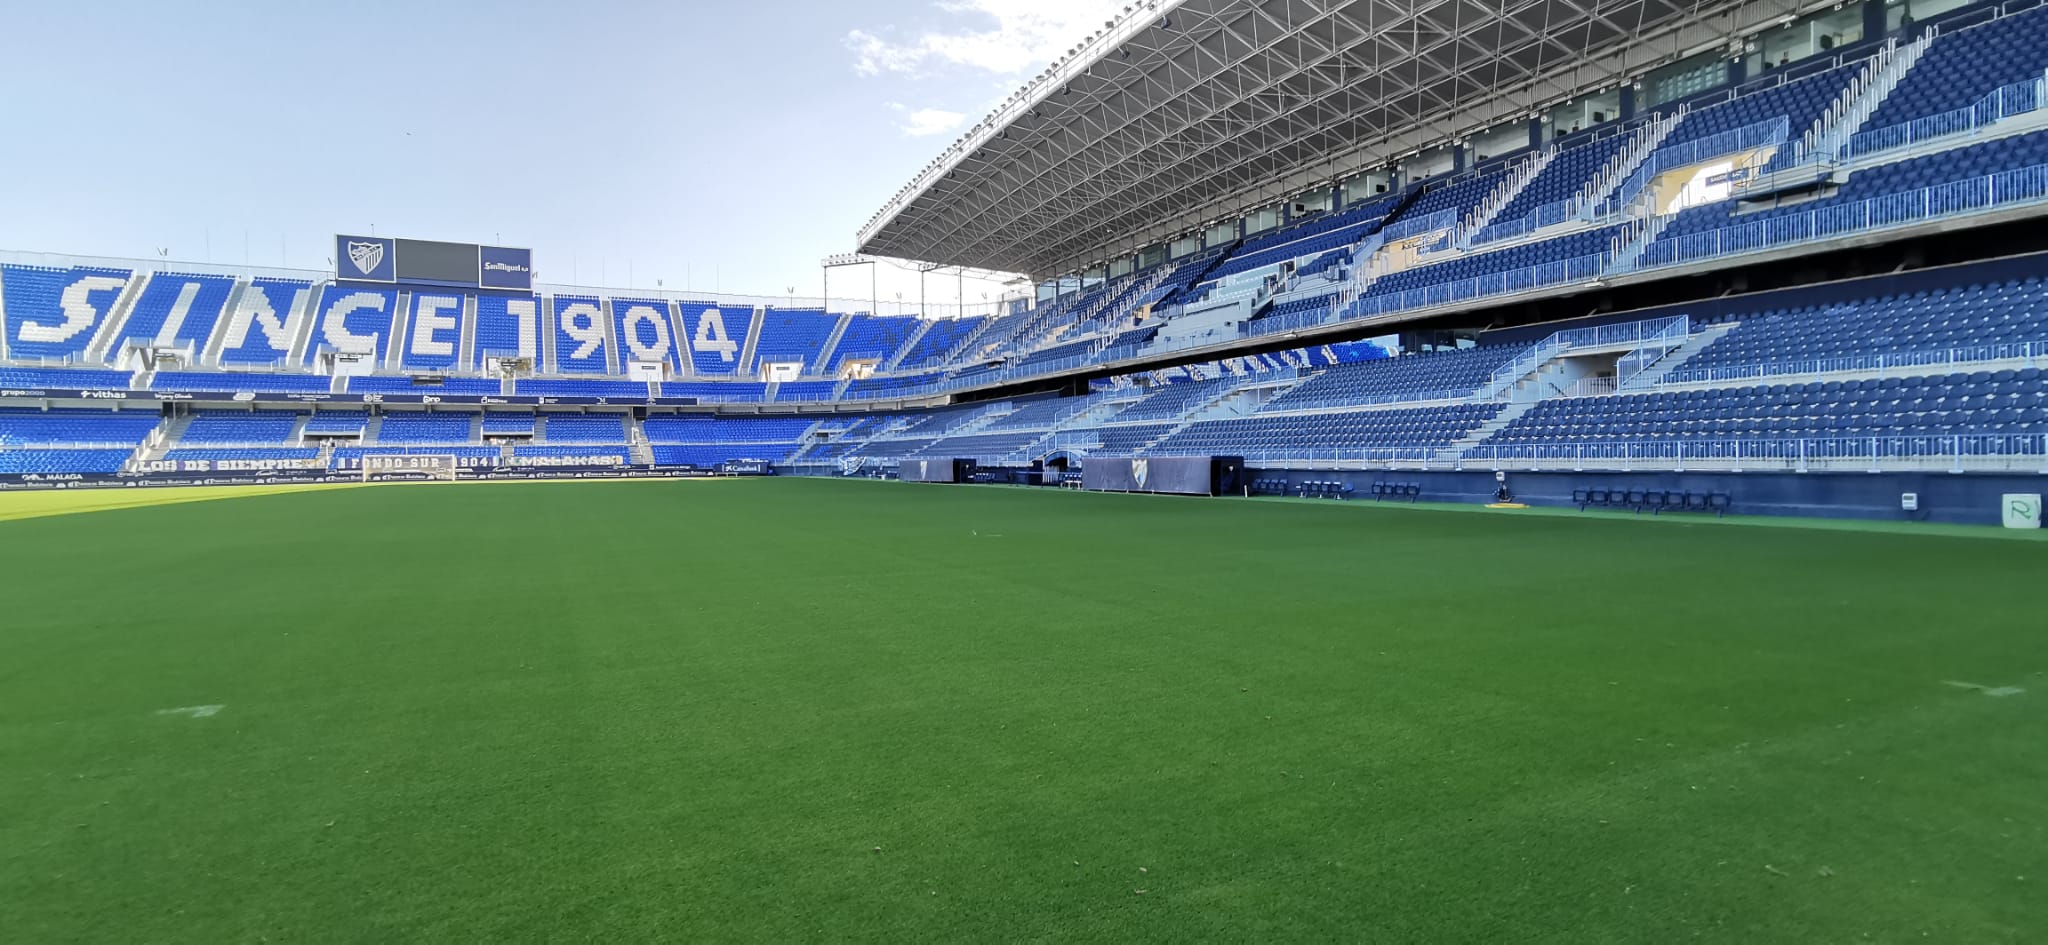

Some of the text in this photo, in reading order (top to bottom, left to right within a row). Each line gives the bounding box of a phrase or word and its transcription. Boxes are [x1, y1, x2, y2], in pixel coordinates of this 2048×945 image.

[18, 276, 738, 362] SINCE 1904
[92, 390, 127, 399] vithas
[138, 458, 302, 472] LOS DE SIEMPRE
[410, 457, 440, 468] SUR
[46, 473, 83, 481] MÁLAGA
